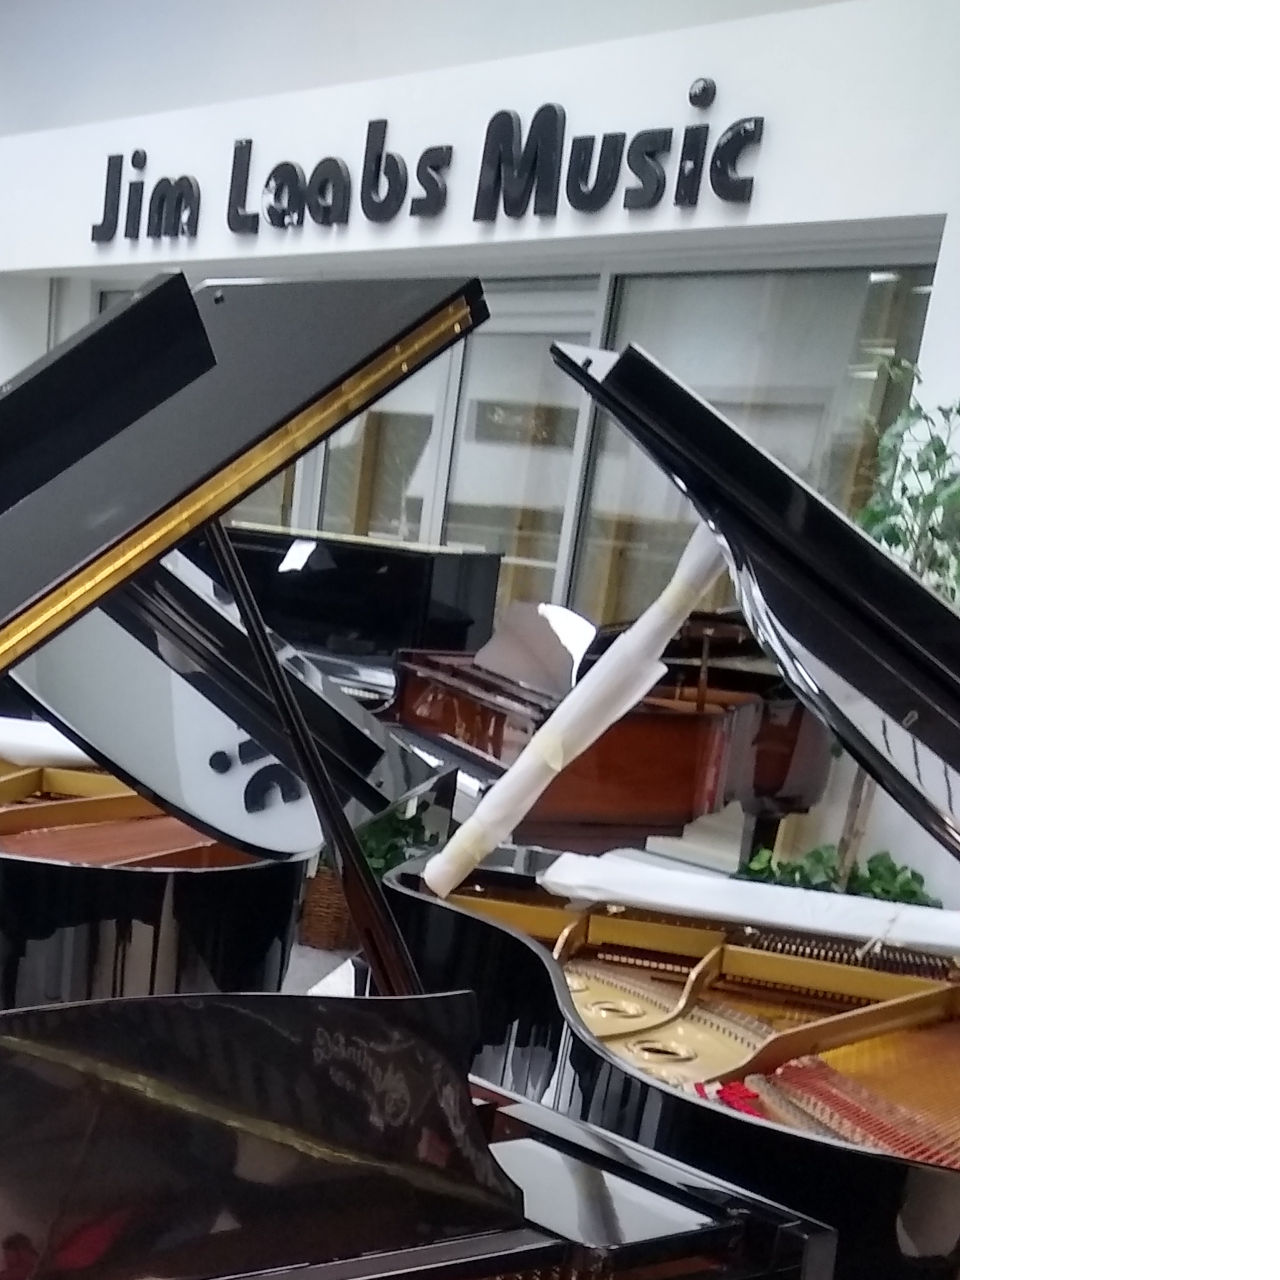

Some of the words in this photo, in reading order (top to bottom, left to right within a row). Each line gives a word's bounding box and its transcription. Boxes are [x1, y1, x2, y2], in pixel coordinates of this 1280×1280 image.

[91, 148, 201, 242] Jim
[227, 118, 453, 236] Laabs
[473, 77, 764, 222] Music
